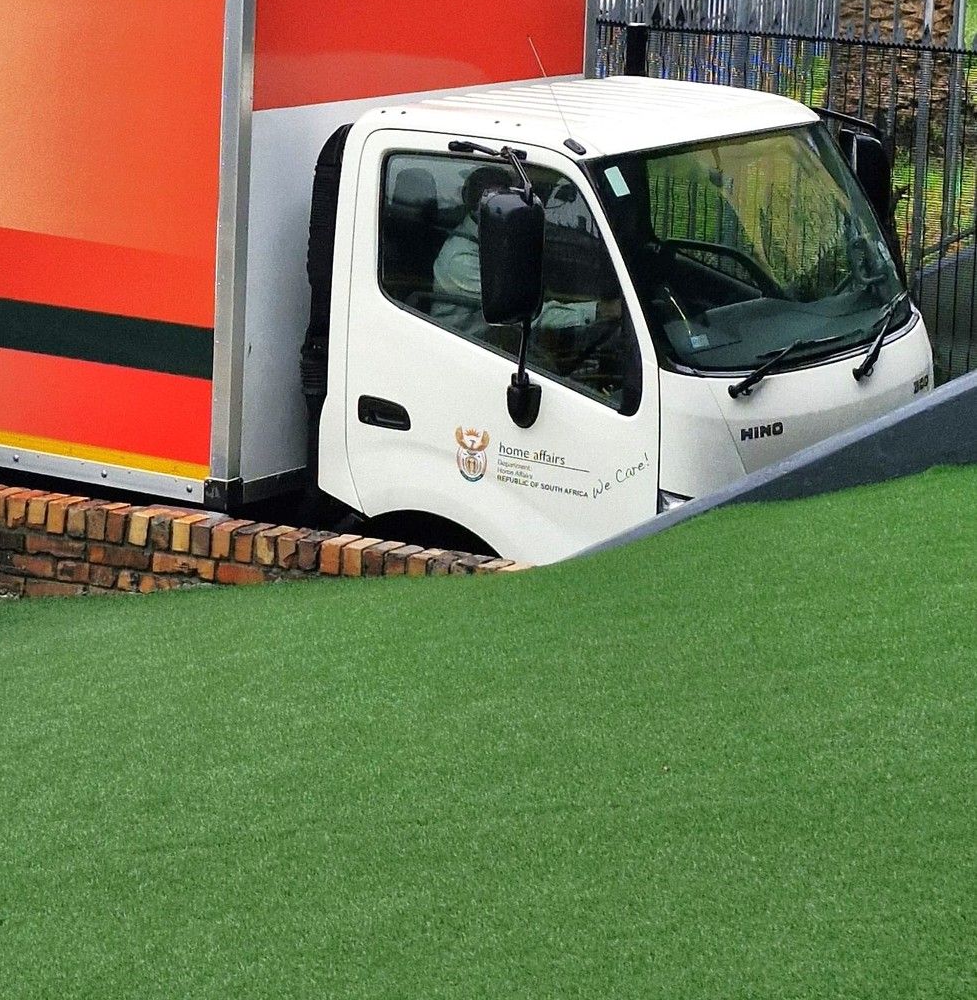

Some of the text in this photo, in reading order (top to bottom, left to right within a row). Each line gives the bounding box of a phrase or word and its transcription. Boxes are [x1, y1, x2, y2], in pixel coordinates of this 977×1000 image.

[741, 421, 784, 442] HINO
[499, 441, 566, 466] home affairs
[497, 474, 589, 498] REPUBLIC OF SOUTH AFRICA
[592, 451, 650, 499] We Care!
